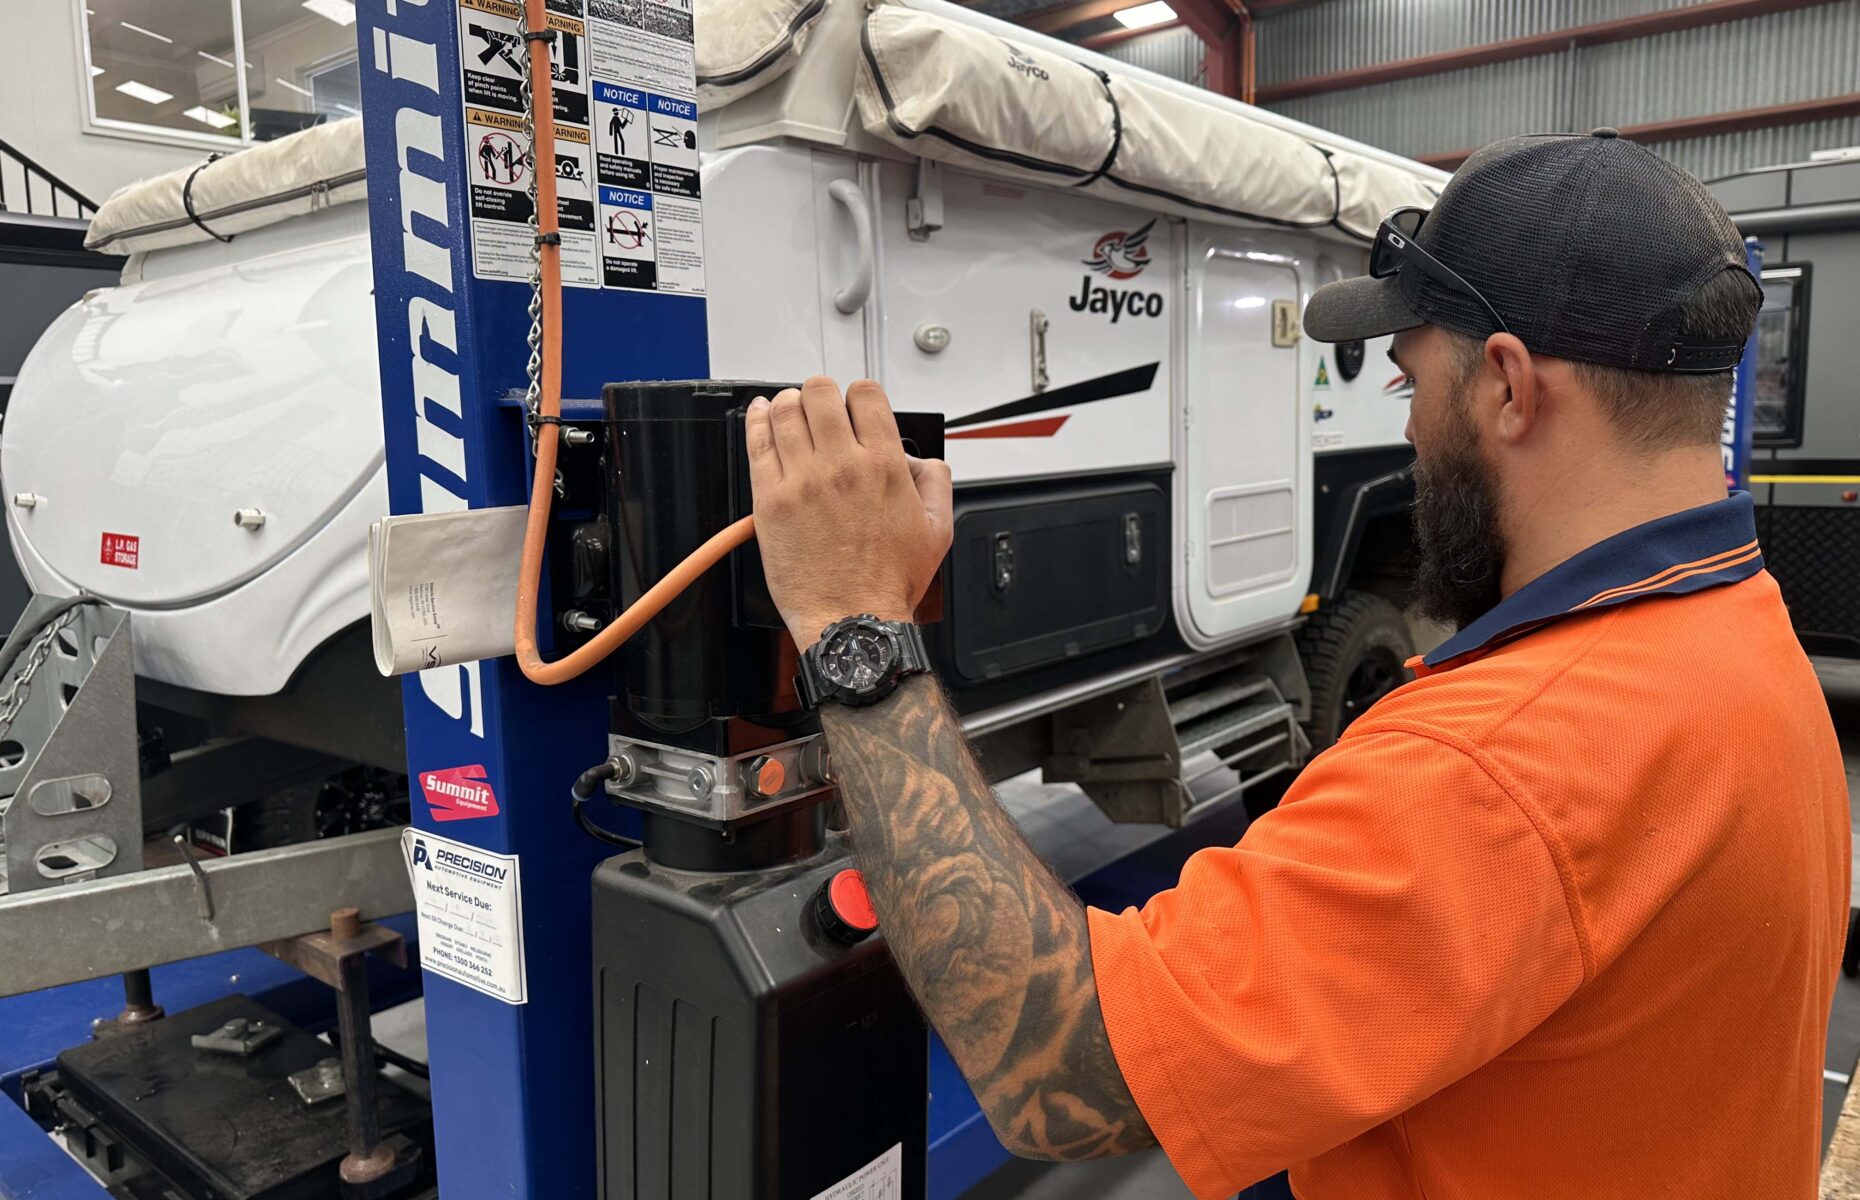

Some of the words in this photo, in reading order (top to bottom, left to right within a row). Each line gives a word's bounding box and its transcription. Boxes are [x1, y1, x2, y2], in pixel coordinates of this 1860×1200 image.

[476, 0, 520, 17] WARNING
[546, 16, 580, 32] ARNING
[467, 72, 481, 81] Keep
[1008, 56, 1049, 81] Jayco
[490, 85, 507, 93] points
[603, 87, 639, 104] NOTICE
[657, 99, 691, 116] NOTICE
[485, 114, 525, 129] WARNIN
[553, 127, 587, 141] ARNING
[609, 191, 645, 206] NOTICE
[1069, 275, 1163, 324] Jayco
[426, 774, 490, 805] Summit
[456, 798, 488, 812] Equipment
[436, 849, 508, 880] PRECISION
[434, 865, 468, 880] AUTOMOTIVE
[470, 876, 502, 890] EQUIPMENT
[426, 880, 444, 895] Next
[444, 886, 473, 905] Service
[474, 896, 492, 912] Due:
[432, 946, 454, 961] PHONE:
[454, 955, 468, 968] 1300
[480, 966, 493, 977] 252
